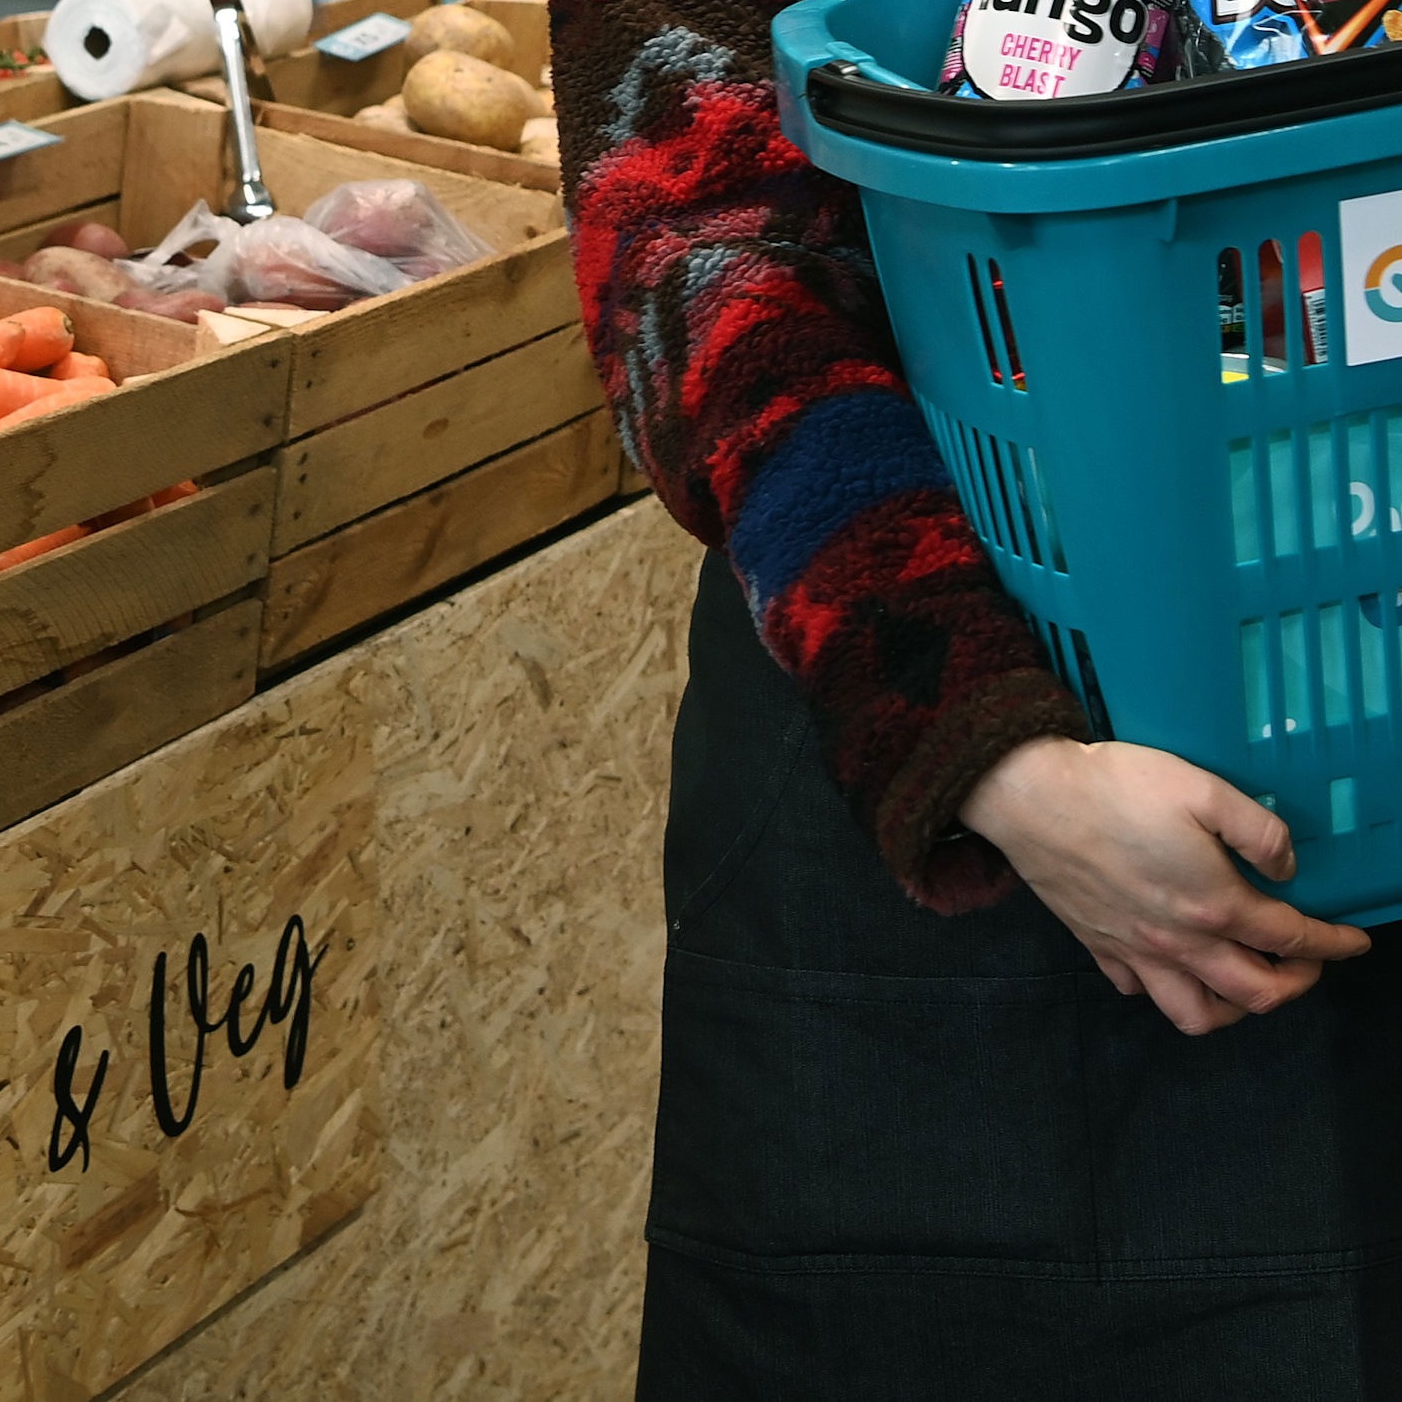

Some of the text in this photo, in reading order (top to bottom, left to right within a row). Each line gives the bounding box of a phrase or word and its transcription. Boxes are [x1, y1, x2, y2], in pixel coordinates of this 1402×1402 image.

[1000, 32, 1084, 72] CHERRY
[998, 63, 1066, 99] BLAST
[48, 1025, 110, 1173] &
[148, 914, 329, 1138] Veg
